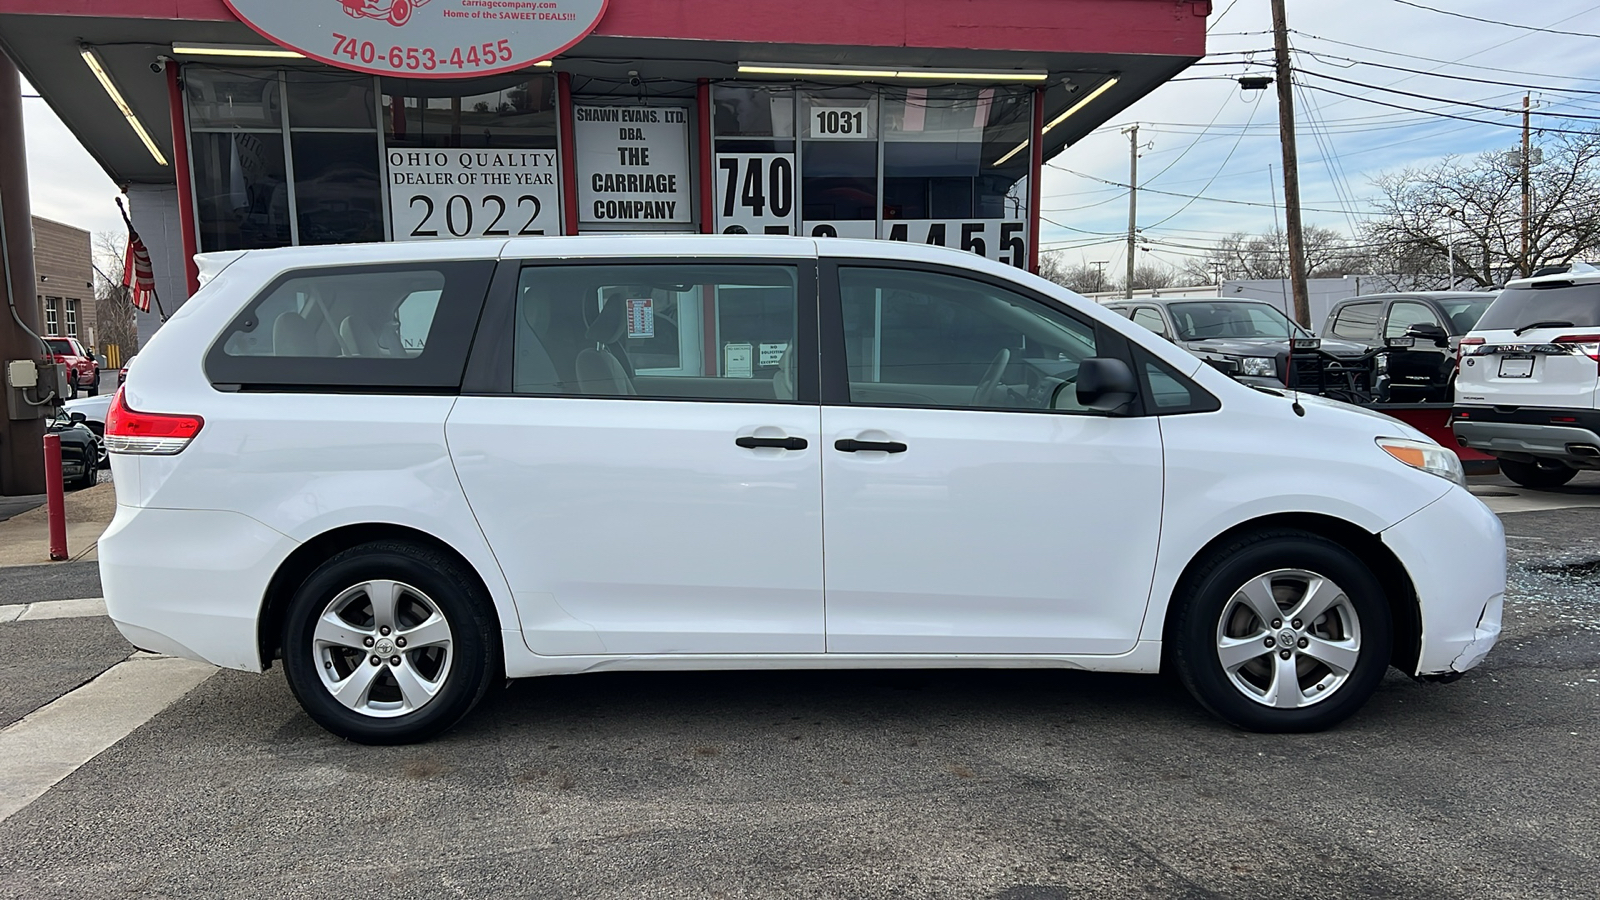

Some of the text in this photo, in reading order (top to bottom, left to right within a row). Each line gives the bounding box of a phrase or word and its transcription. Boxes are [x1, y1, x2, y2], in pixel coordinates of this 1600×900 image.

[462, 0, 557, 10] carriagecompany.com
[443, 10, 469, 18] Home
[471, 10, 482, 18] of
[482, 11, 497, 19] the
[499, 12, 537, 20] SAWEET
[332, 32, 513, 71] 740-653-4455
[577, 108, 686, 124] SHAWN EVANS. LTD.
[816, 111, 862, 134] 1031
[620, 128, 646, 141] DBA.
[390, 153, 555, 169] OHIO QUALITY
[618, 147, 650, 166] THE
[393, 173, 554, 185] DEALER OF THE YEAR
[592, 173, 677, 193] CARRIAGE
[720, 157, 792, 218] 740
[409, 194, 545, 237] 2022
[594, 200, 677, 219] COMPANY
